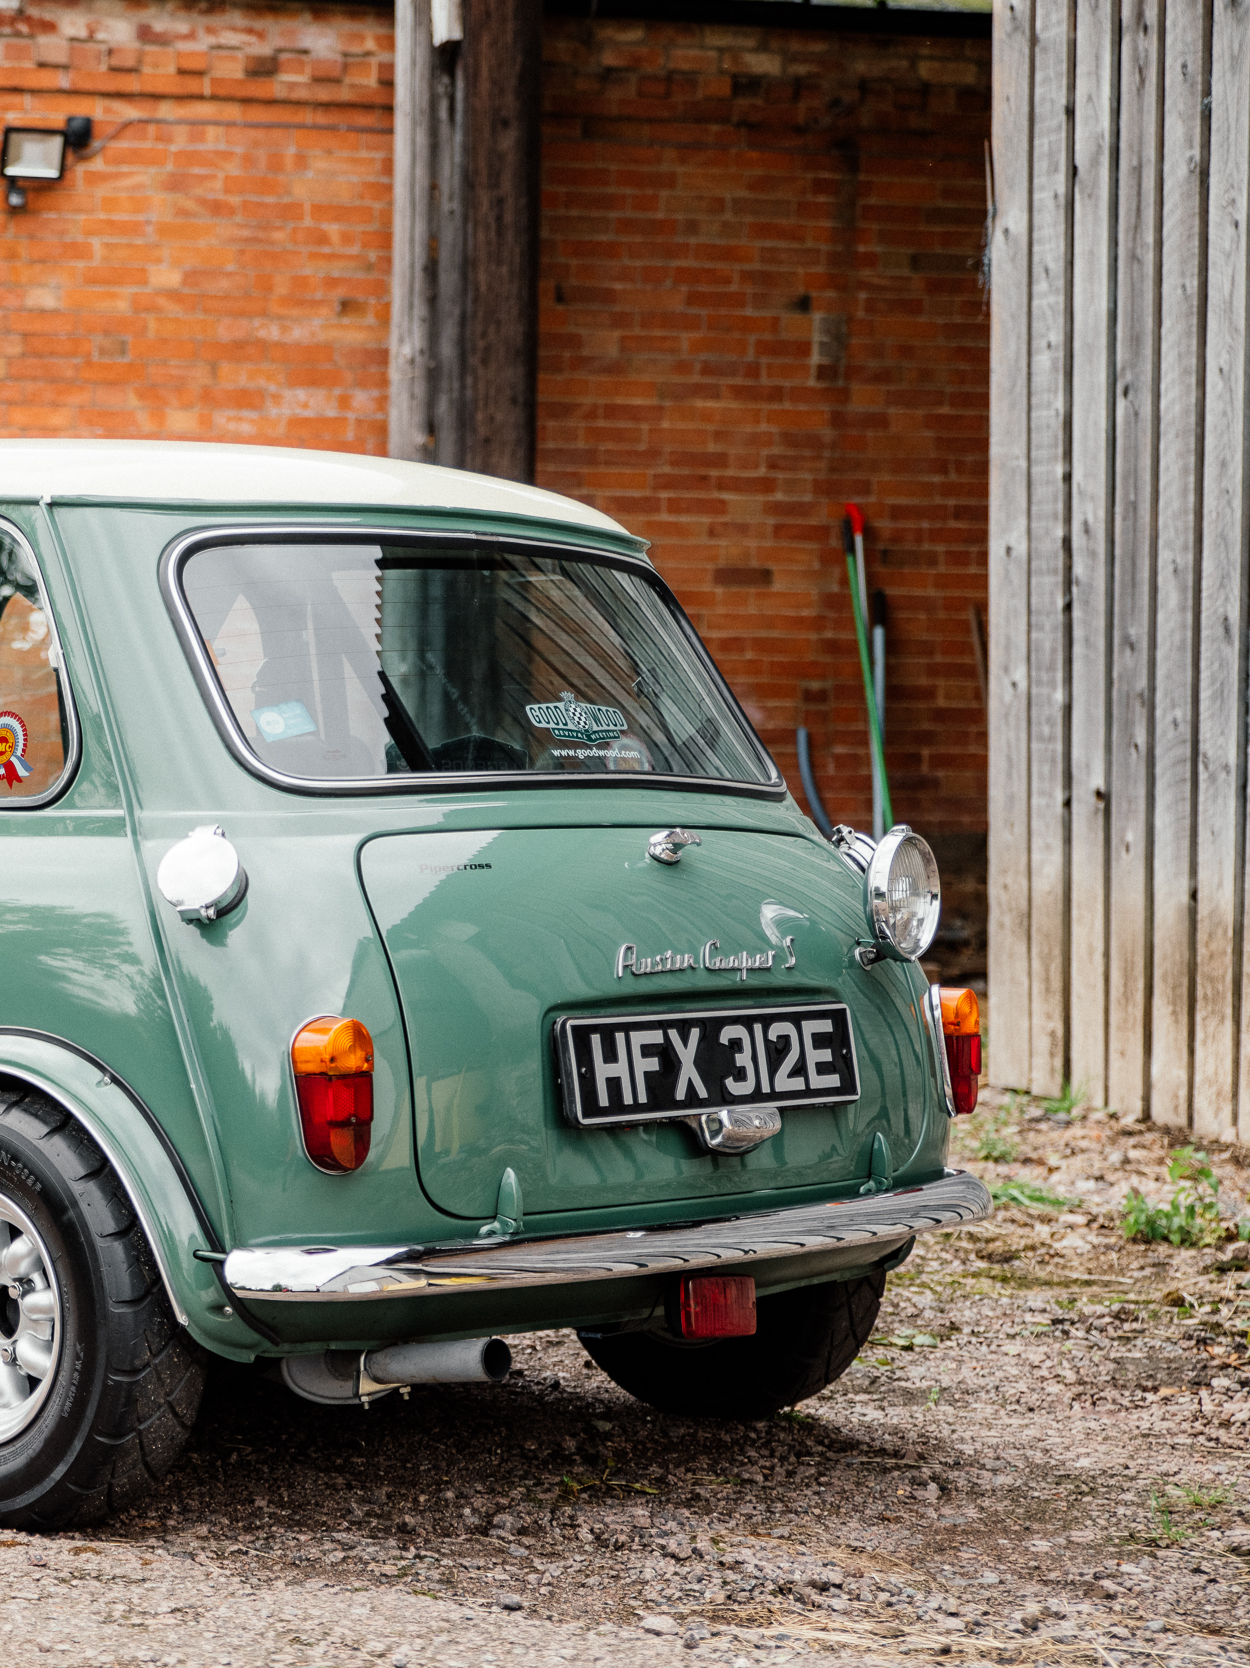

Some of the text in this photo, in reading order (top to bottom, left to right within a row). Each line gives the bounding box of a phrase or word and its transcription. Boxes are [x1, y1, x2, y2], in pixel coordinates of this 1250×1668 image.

[530, 705, 625, 728] GOOD WOOD
[554, 729, 619, 740] REVIVAL MEETING
[551, 747, 640, 760] www.goodwood.com
[420, 862, 492, 875] Pipercross
[616, 935, 797, 981] Austin Cooper S
[590, 1019, 841, 1108] HFX 312E
